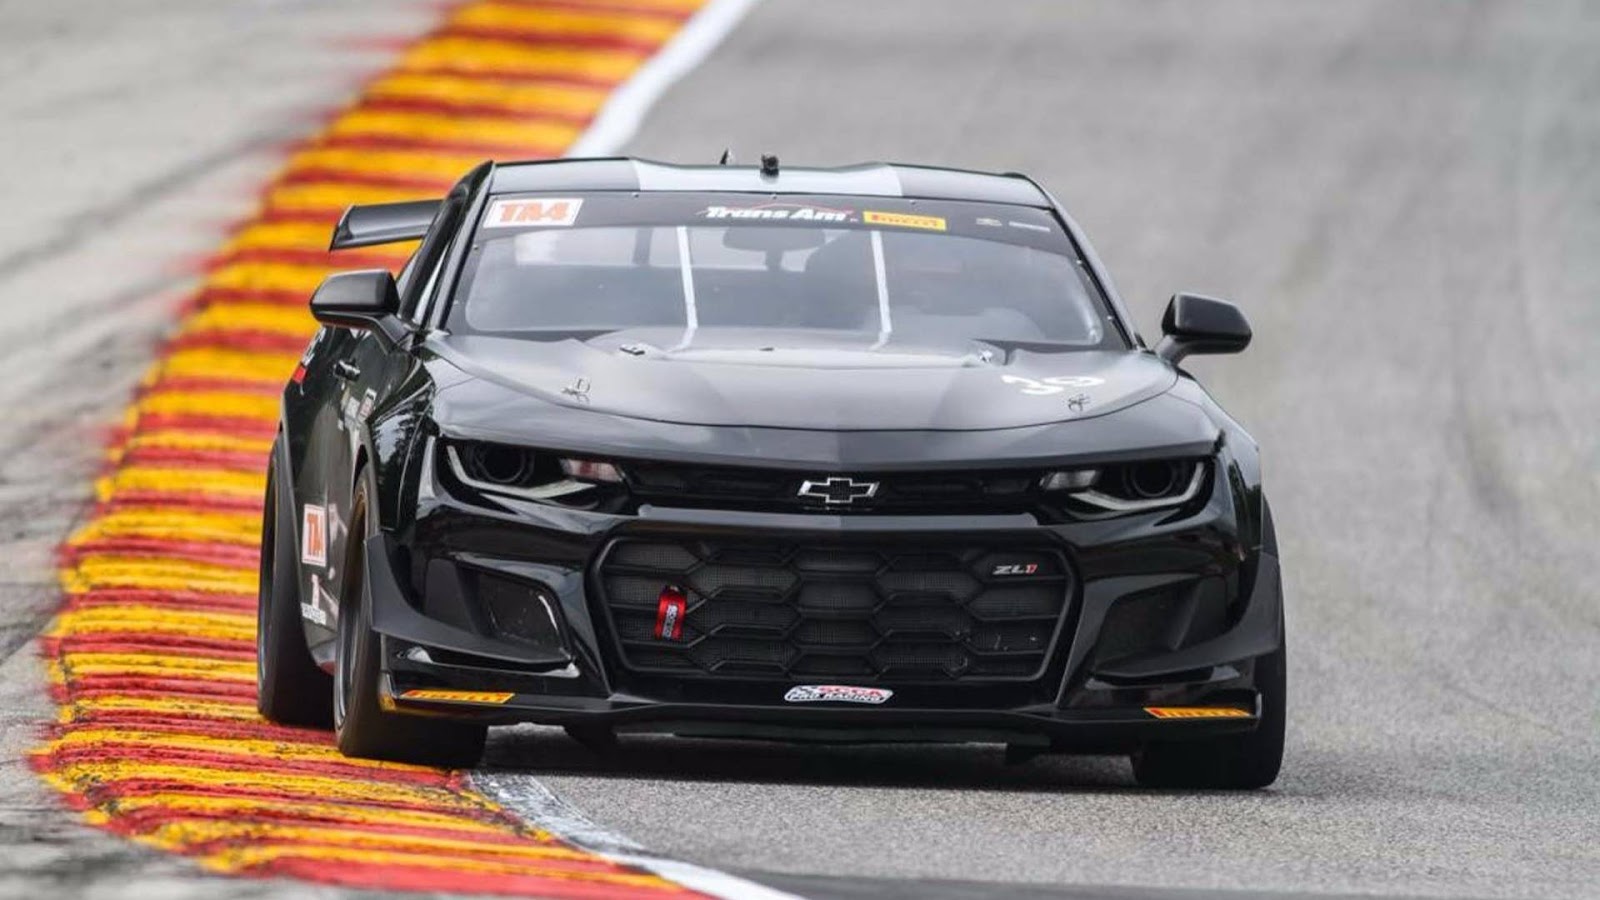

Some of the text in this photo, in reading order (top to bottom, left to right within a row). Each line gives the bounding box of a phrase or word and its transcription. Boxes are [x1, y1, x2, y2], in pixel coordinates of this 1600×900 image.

[500, 202, 569, 222] TA4
[706, 206, 847, 222] Trans Am
[992, 564, 1038, 576] ZL1
